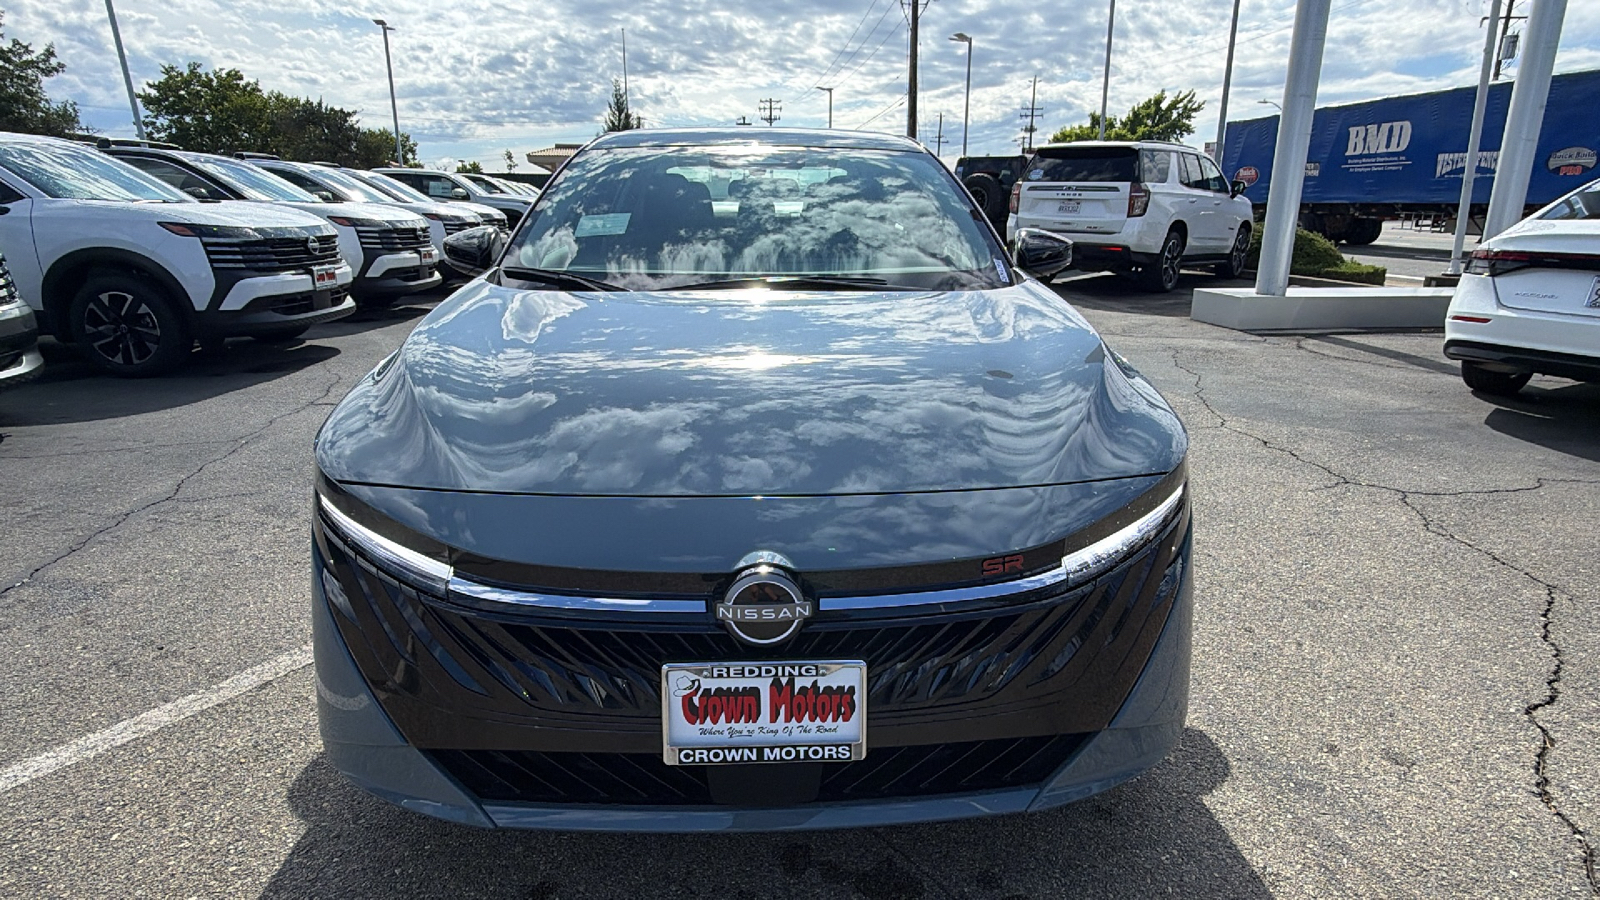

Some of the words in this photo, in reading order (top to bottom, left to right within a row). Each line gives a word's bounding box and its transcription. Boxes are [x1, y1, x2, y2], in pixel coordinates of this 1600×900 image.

[1345, 121, 1412, 156] BMD
[982, 554, 1024, 576] SR
[718, 604, 811, 621] NISSAN
[712, 665, 817, 678] REDDING
[681, 679, 762, 725] Crown
[769, 677, 856, 724] Motors
[699, 727, 725, 736] Where
[727, 726, 755, 738] You're
[758, 726, 779, 737] King
[782, 726, 794, 737] Of
[796, 725, 812, 734] The
[815, 725, 839, 734] Road
[680, 748, 758, 763] CROWN
[763, 745, 851, 761] MOTORS
